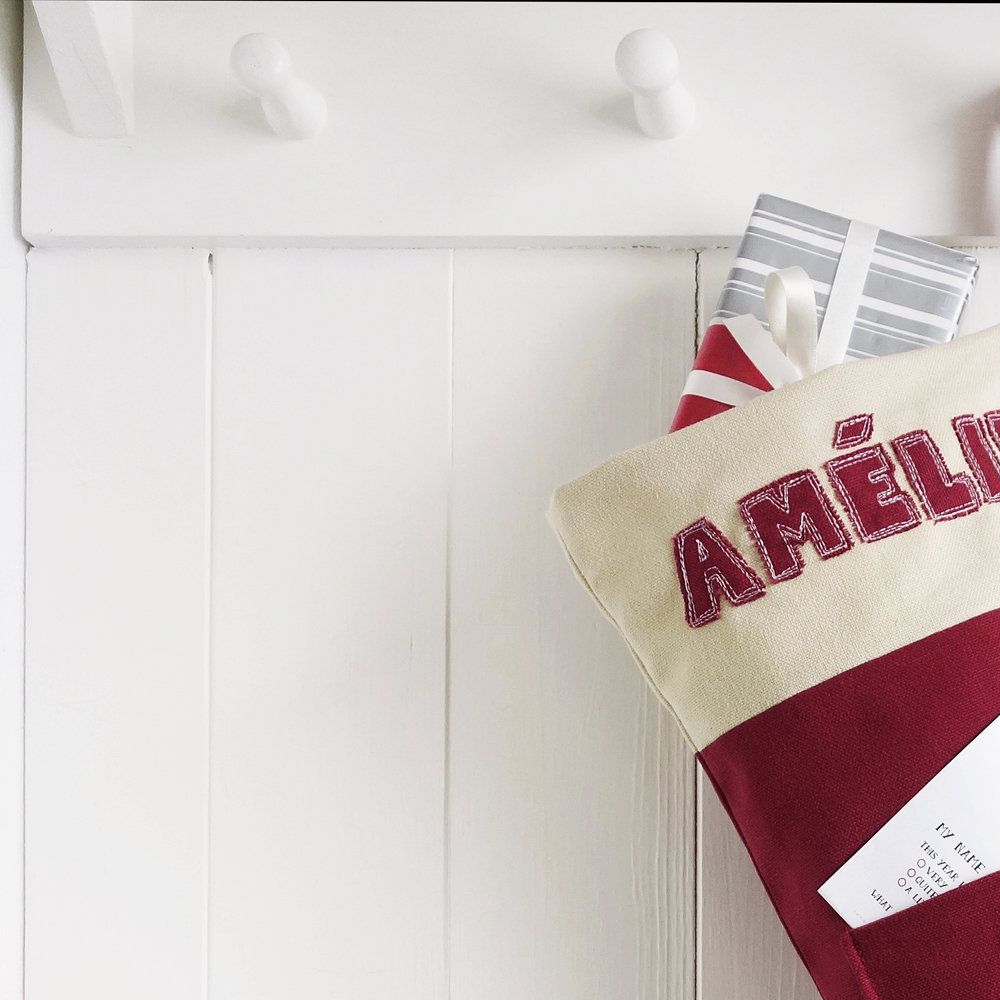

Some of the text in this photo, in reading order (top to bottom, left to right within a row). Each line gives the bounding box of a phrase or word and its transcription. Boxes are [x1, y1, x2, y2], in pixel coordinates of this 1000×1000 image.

[935, 822, 986, 874] MY NAME
[920, 840, 959, 882] THIS YEAR
[926, 866, 948, 888] VERY
[870, 888, 894, 912] WHAT
[904, 886, 913, 895] A
